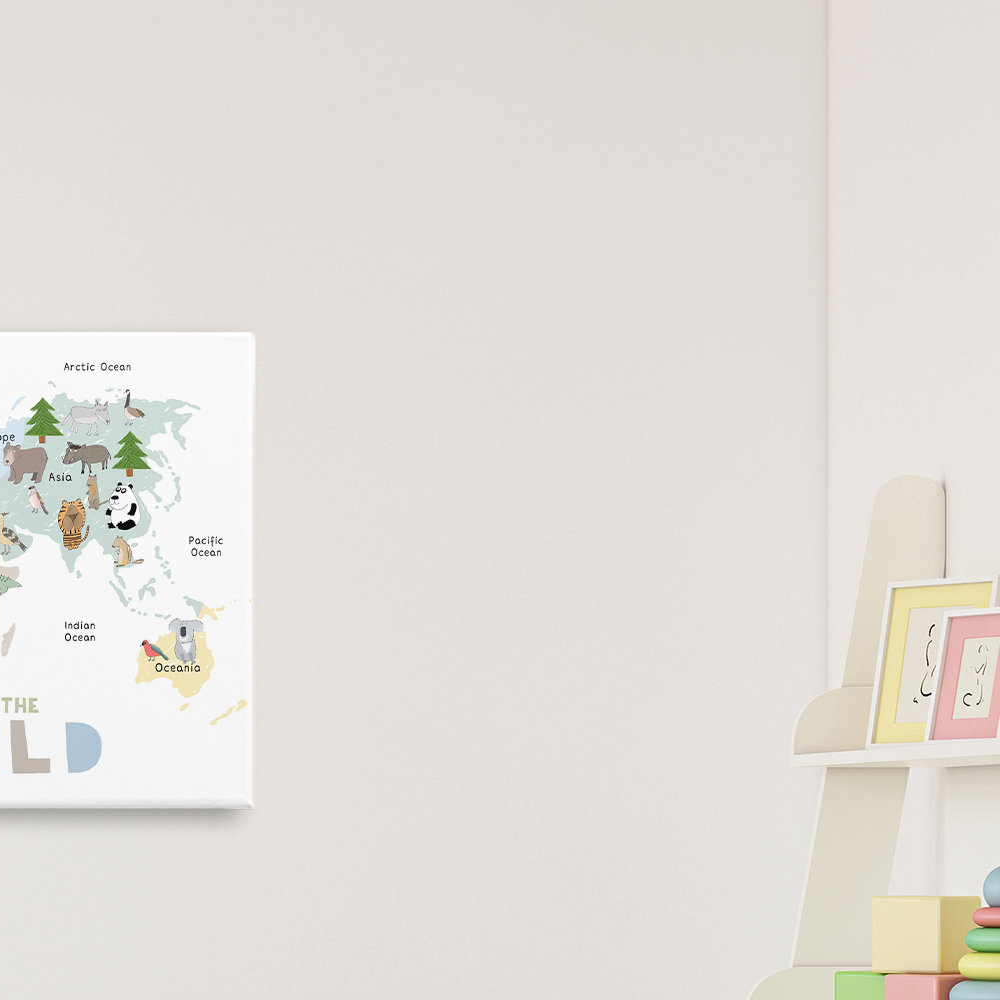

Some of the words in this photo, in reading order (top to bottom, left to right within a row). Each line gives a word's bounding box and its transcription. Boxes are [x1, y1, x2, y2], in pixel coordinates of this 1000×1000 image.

[64, 362, 95, 372] Arctic
[100, 362, 132, 372] Ocean
[48, 472, 73, 482] Asia
[188, 535, 224, 546] Pacific
[190, 547, 222, 557] Ocean
[64, 621, 96, 630] Indian
[64, 632, 96, 642] Ocean
[154, 662, 201, 673] Oceania
[1, 697, 39, 714] THE
